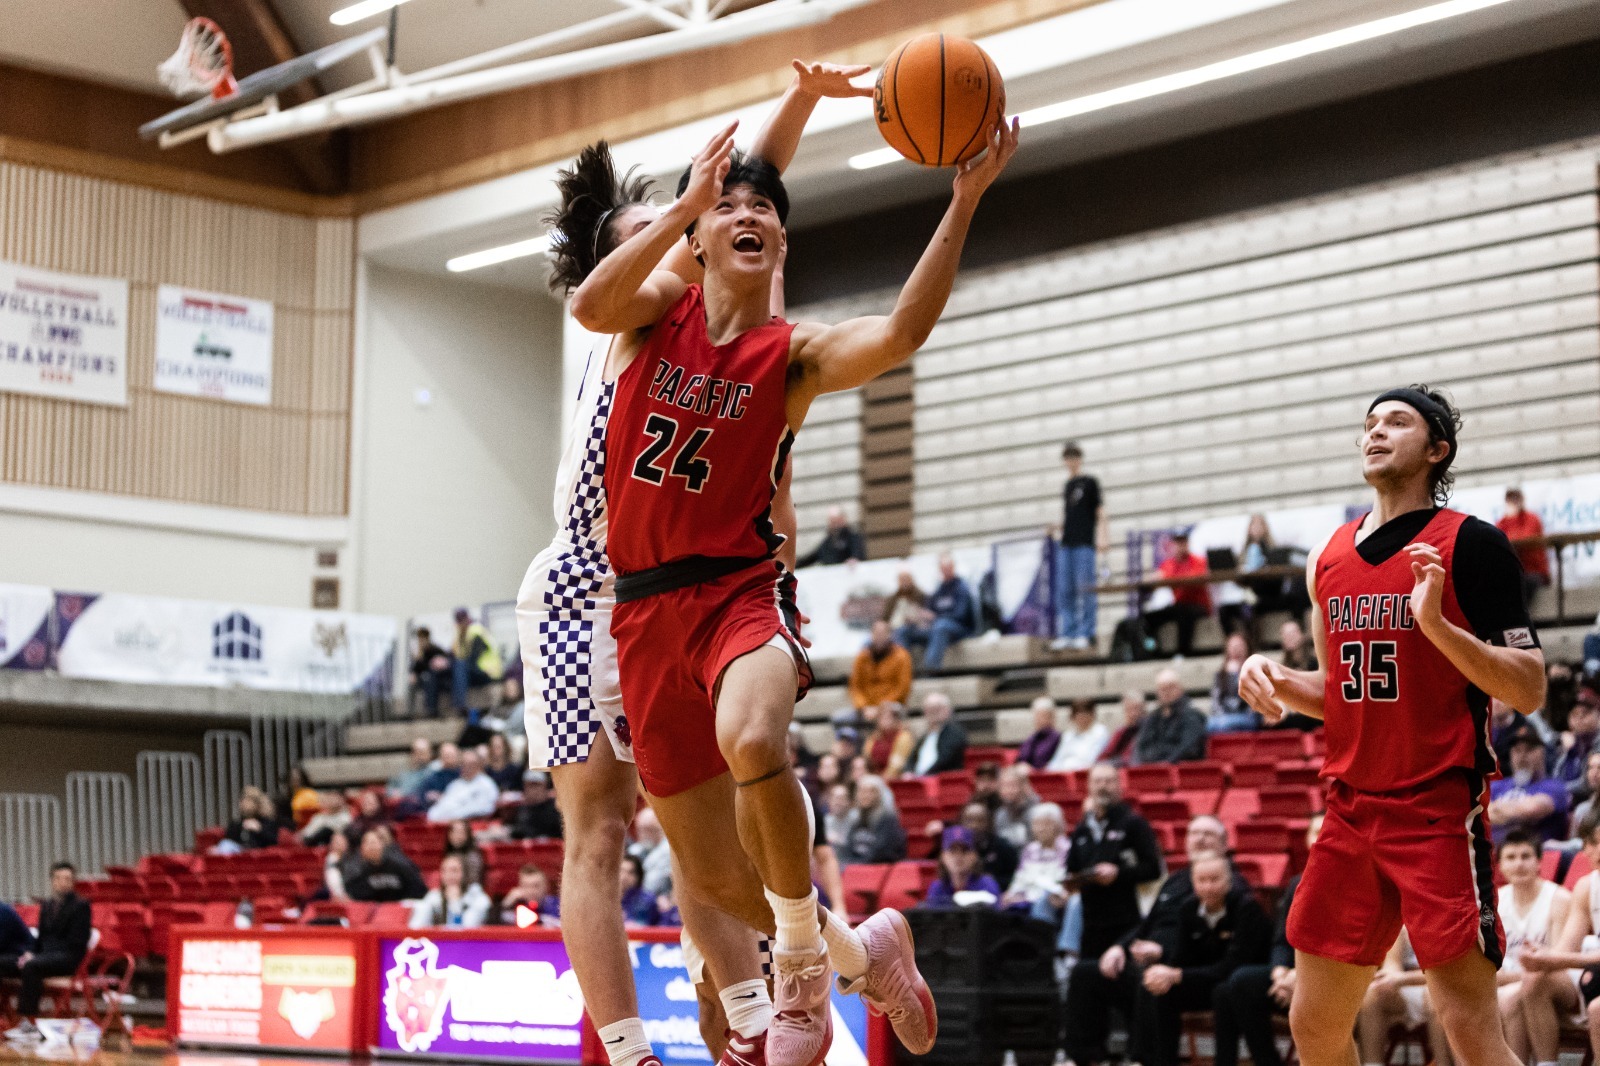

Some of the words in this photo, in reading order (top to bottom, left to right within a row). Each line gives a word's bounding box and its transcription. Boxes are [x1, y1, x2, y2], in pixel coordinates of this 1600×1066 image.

[0, 338, 117, 376] HAMPIONS
[648, 358, 753, 420] PACIFIC
[631, 412, 714, 494] 24
[1328, 594, 1415, 633] PACIFIC
[1340, 640, 1399, 703] 35
